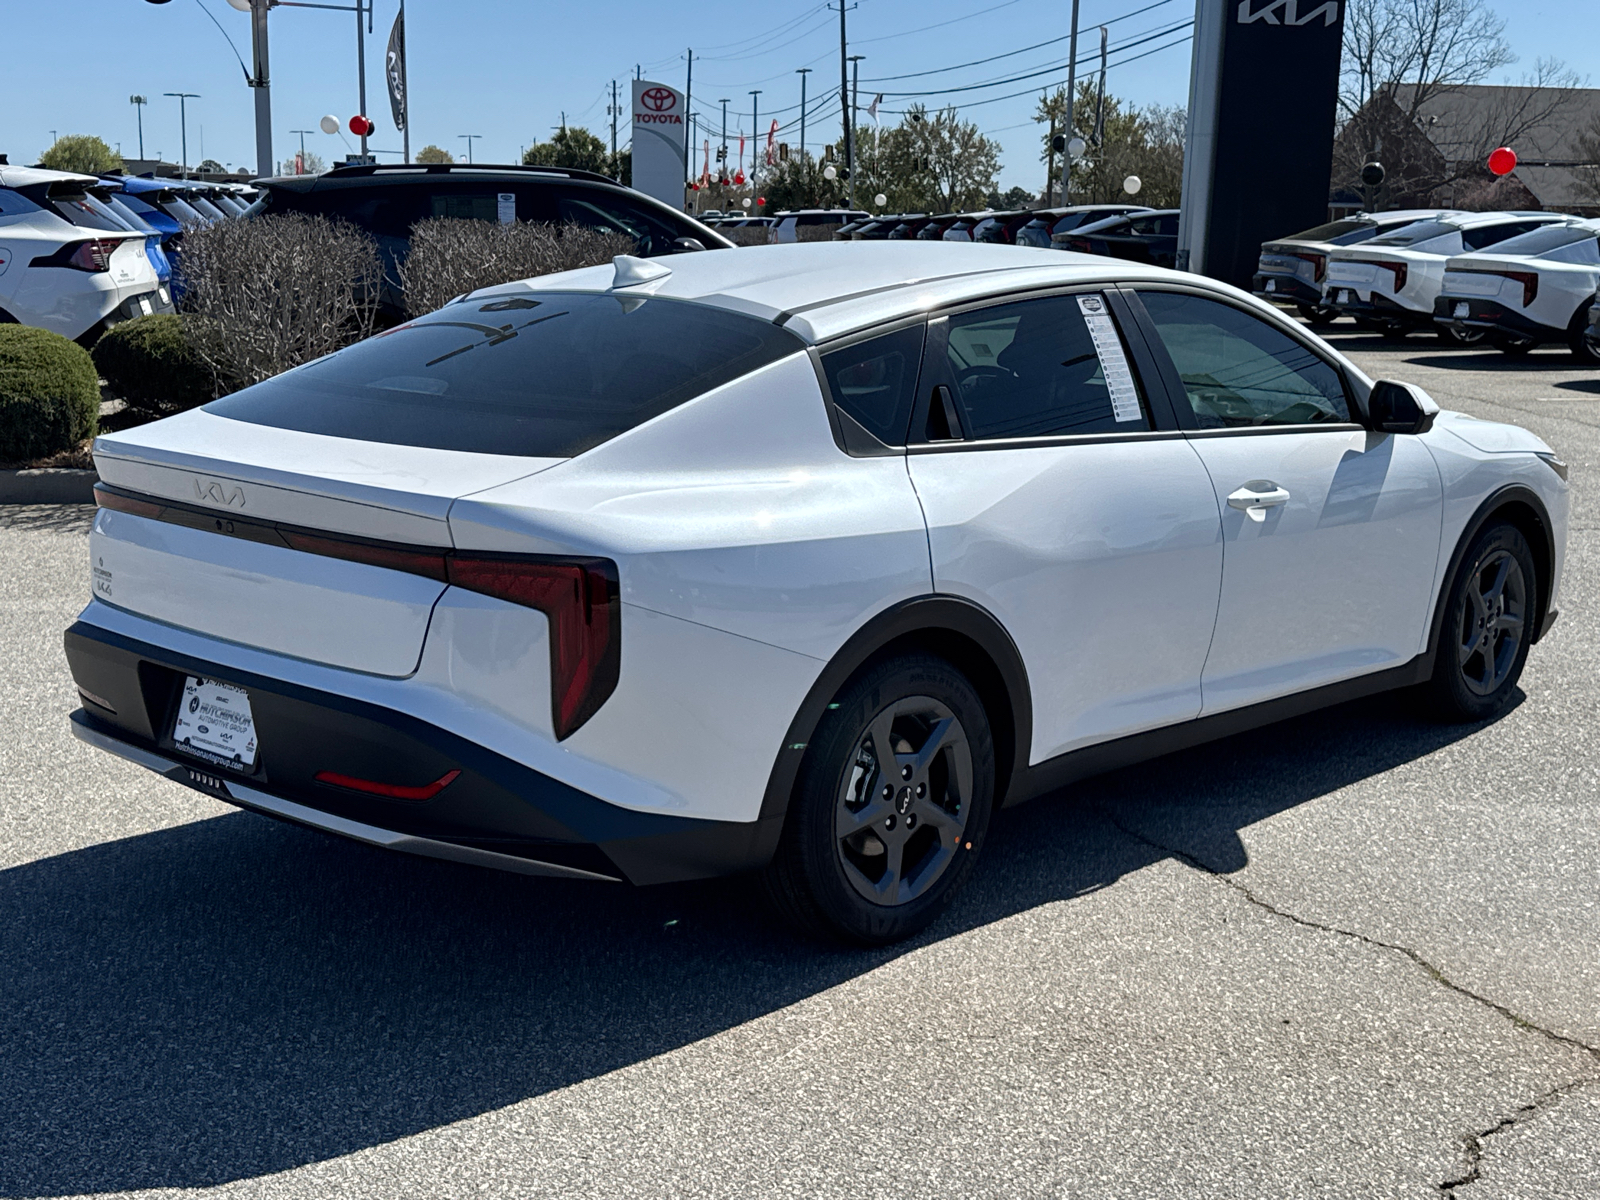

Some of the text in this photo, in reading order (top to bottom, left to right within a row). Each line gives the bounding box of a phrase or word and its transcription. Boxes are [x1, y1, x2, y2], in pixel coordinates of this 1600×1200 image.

[1237, 0, 1338, 27] KIA
[635, 113, 682, 124] TOYOTA
[193, 478, 246, 507] KIA
[198, 714, 229, 729] AUTOMOTIVE
[230, 723, 247, 734] GROUP
[199, 704, 252, 727] HUTCHINSON
